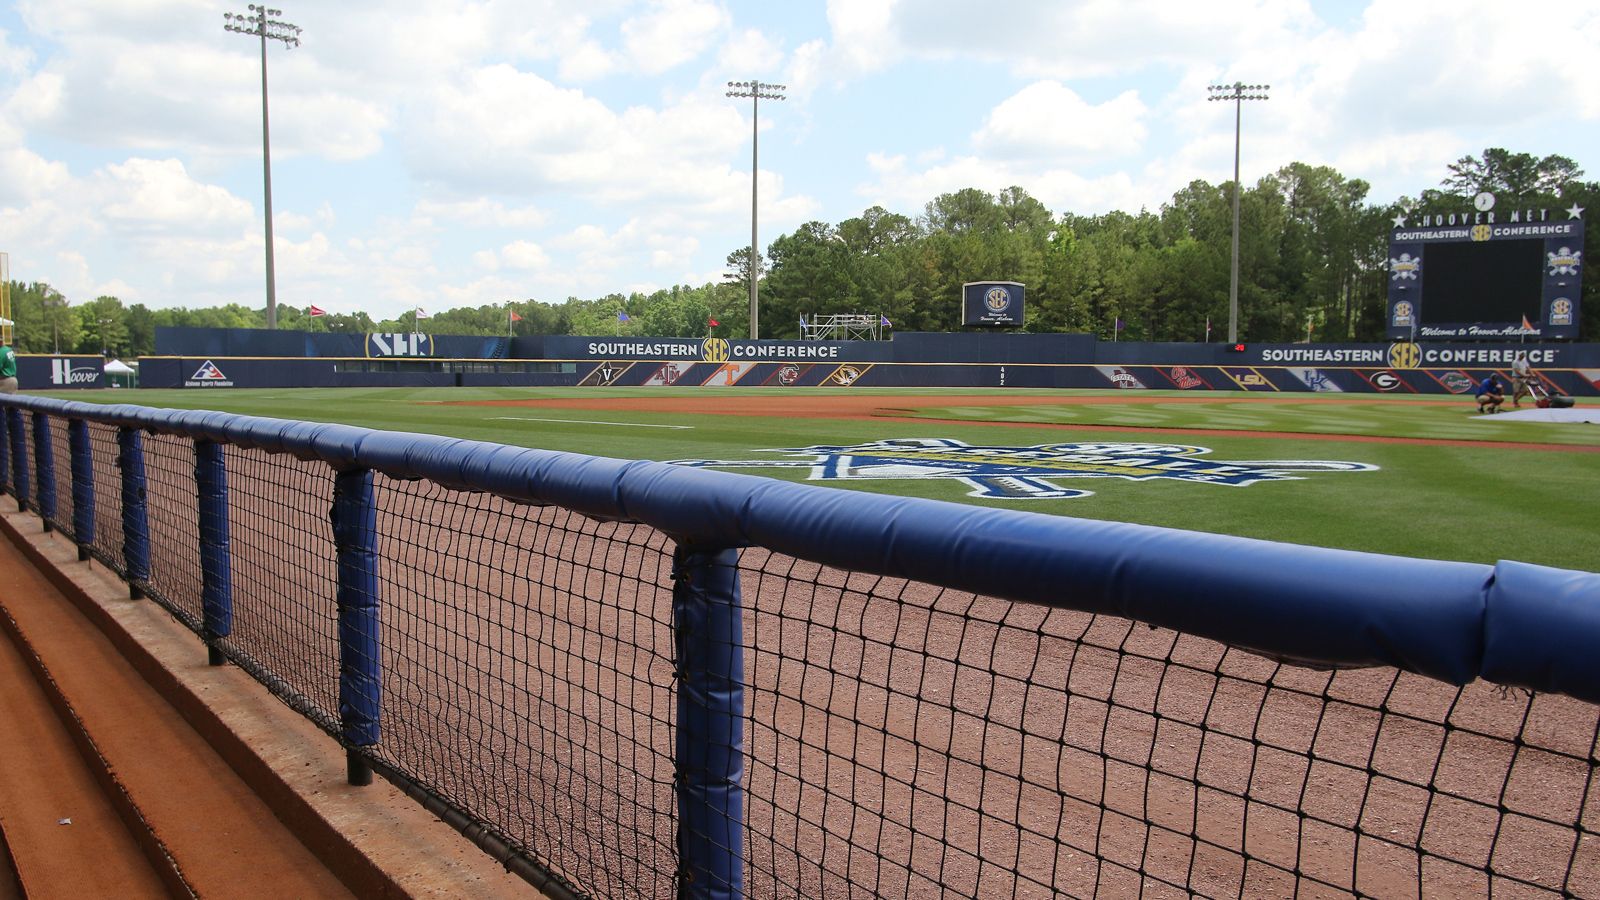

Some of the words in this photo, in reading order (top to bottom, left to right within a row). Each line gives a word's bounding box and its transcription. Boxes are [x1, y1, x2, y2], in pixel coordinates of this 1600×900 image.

[1423, 211, 1495, 227] HOOVER
[1510, 208, 1547, 223] MET
[1395, 230, 1469, 240] SOUTHEASTERN
[1493, 225, 1570, 236] CONFERENCE
[989, 289, 1007, 308] SEC
[1421, 327, 1456, 336] Welcome
[588, 343, 697, 356] SOUTHEASTERN
[703, 338, 729, 362] SEC
[733, 345, 838, 357] CONFERENCE
[1262, 349, 1383, 362] SOUTHEASTERN
[1391, 343, 1419, 368] SEC
[1425, 349, 1554, 362] CONFERENCE
[52, 359, 99, 384] Hoover
[603, 368, 612, 381] V
[724, 364, 739, 385] T
[1235, 375, 1265, 385] LSU
